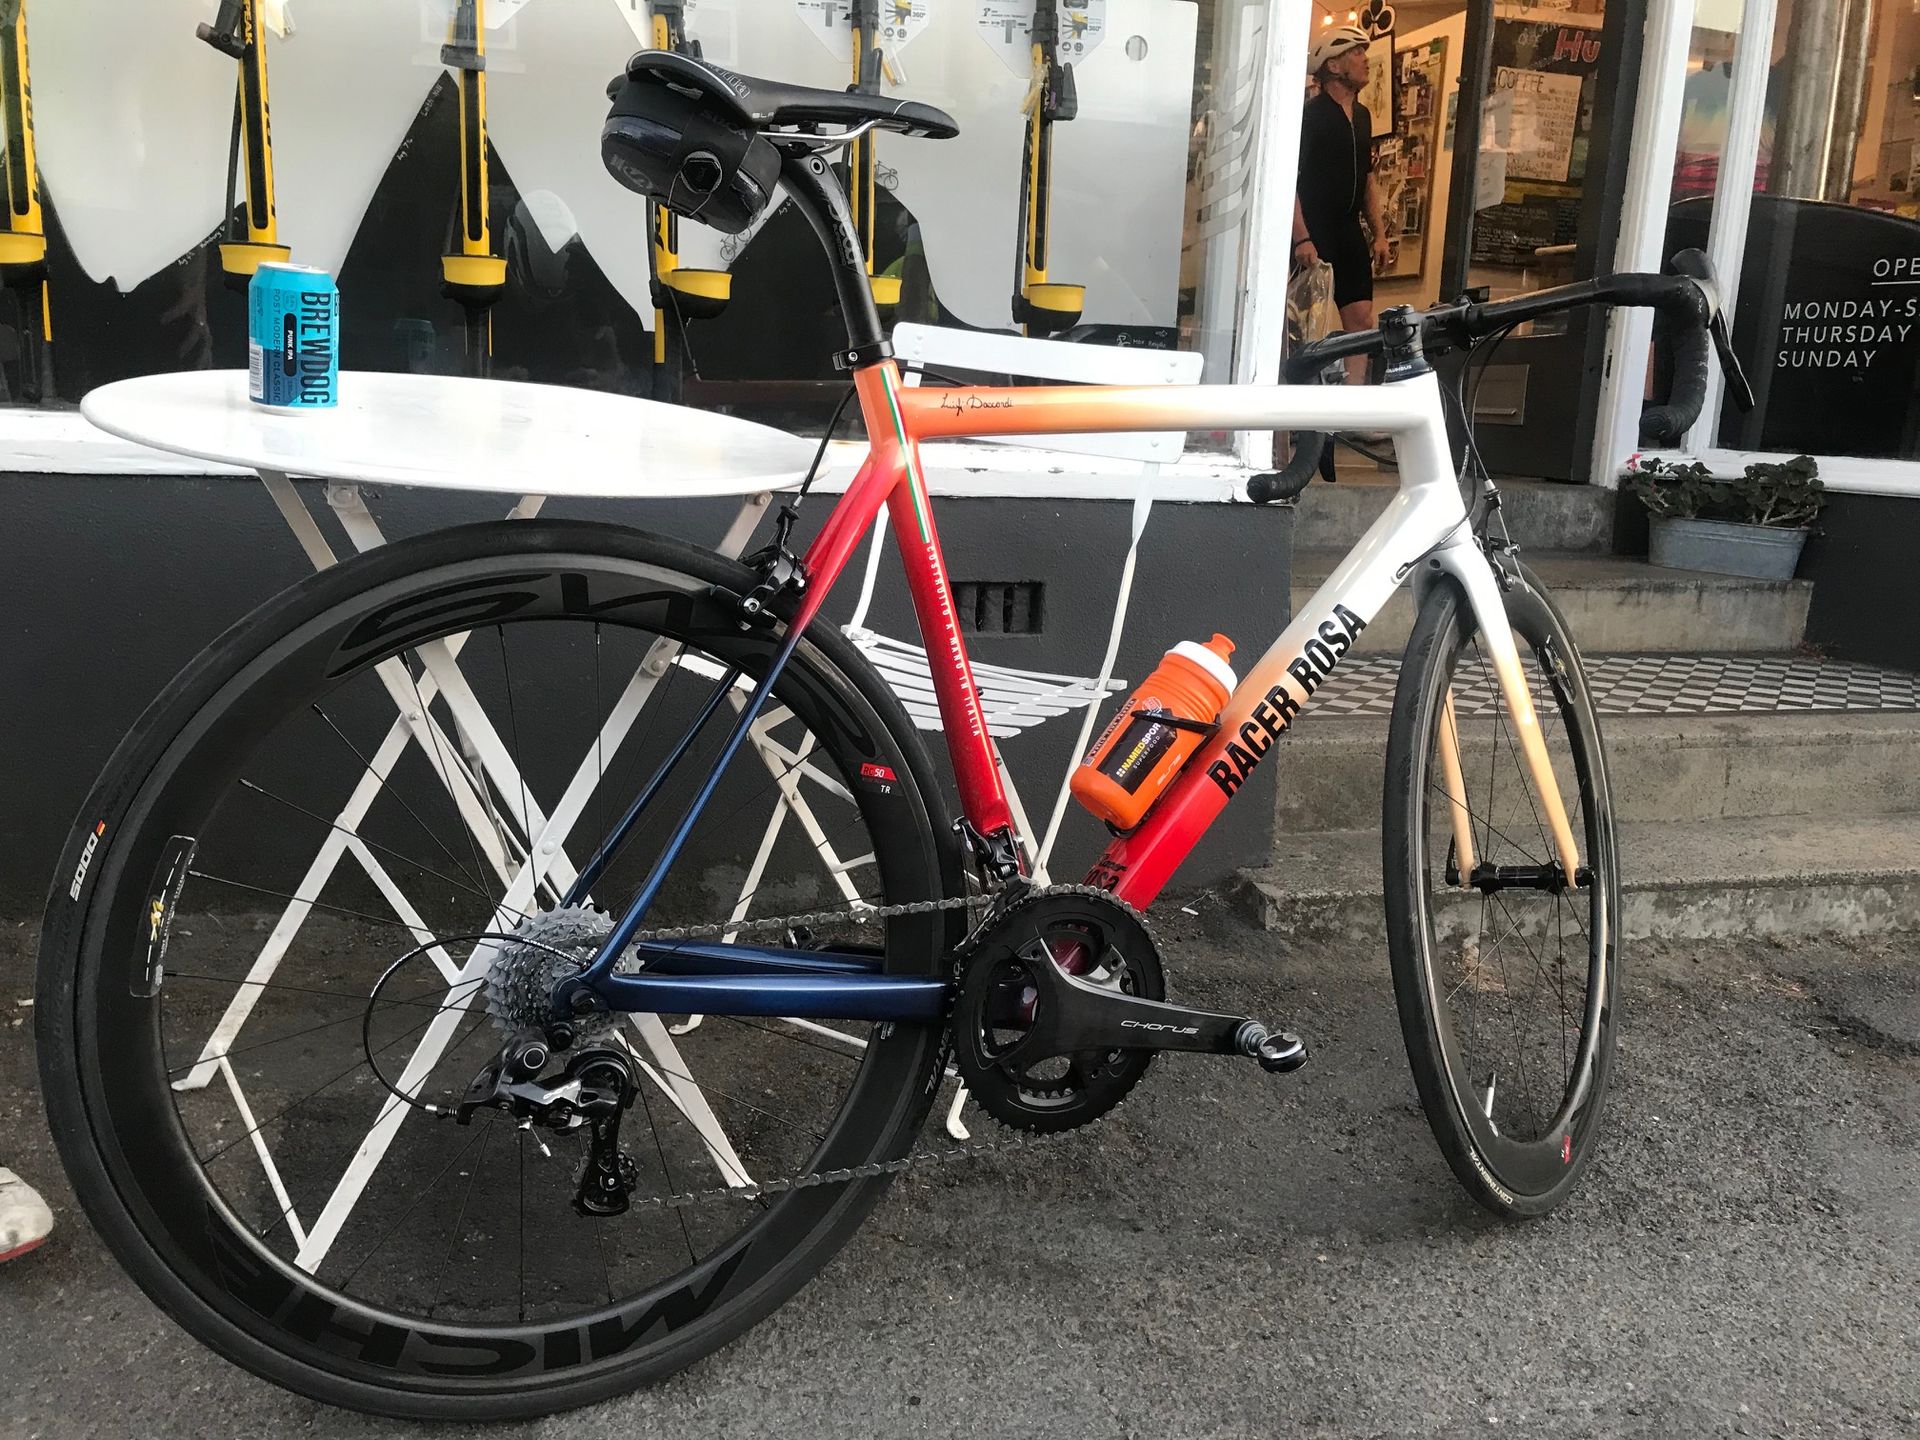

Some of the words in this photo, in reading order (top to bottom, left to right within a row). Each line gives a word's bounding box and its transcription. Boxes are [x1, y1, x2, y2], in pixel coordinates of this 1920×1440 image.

[1497, 69, 1545, 94] COFFEE
[273, 288, 281, 314] POST
[1784, 298, 1920, 320] MONDAY-S
[273, 317, 281, 359] MODERN
[301, 291, 331, 404] BREWDOG
[1782, 325, 1912, 344] THURSDAY
[1777, 350, 1877, 368] SUNDAY
[273, 361, 281, 402] CLASSIC
[949, 637, 964, 670] MANO
[958, 676, 970, 690] IN
[1206, 685, 1301, 800] RACER
[1286, 603, 1368, 697] ROSA
[963, 696, 982, 738] ITALIA
[1121, 722, 1161, 771] NAMEDSPOR
[1133, 735, 1160, 769] SUPERFOOD
[881, 785, 891, 794] TR
[69, 831, 99, 902] 5000
[1469, 1145, 1514, 1205] CONTINENTAL
[206, 1200, 753, 1376] MICHE
